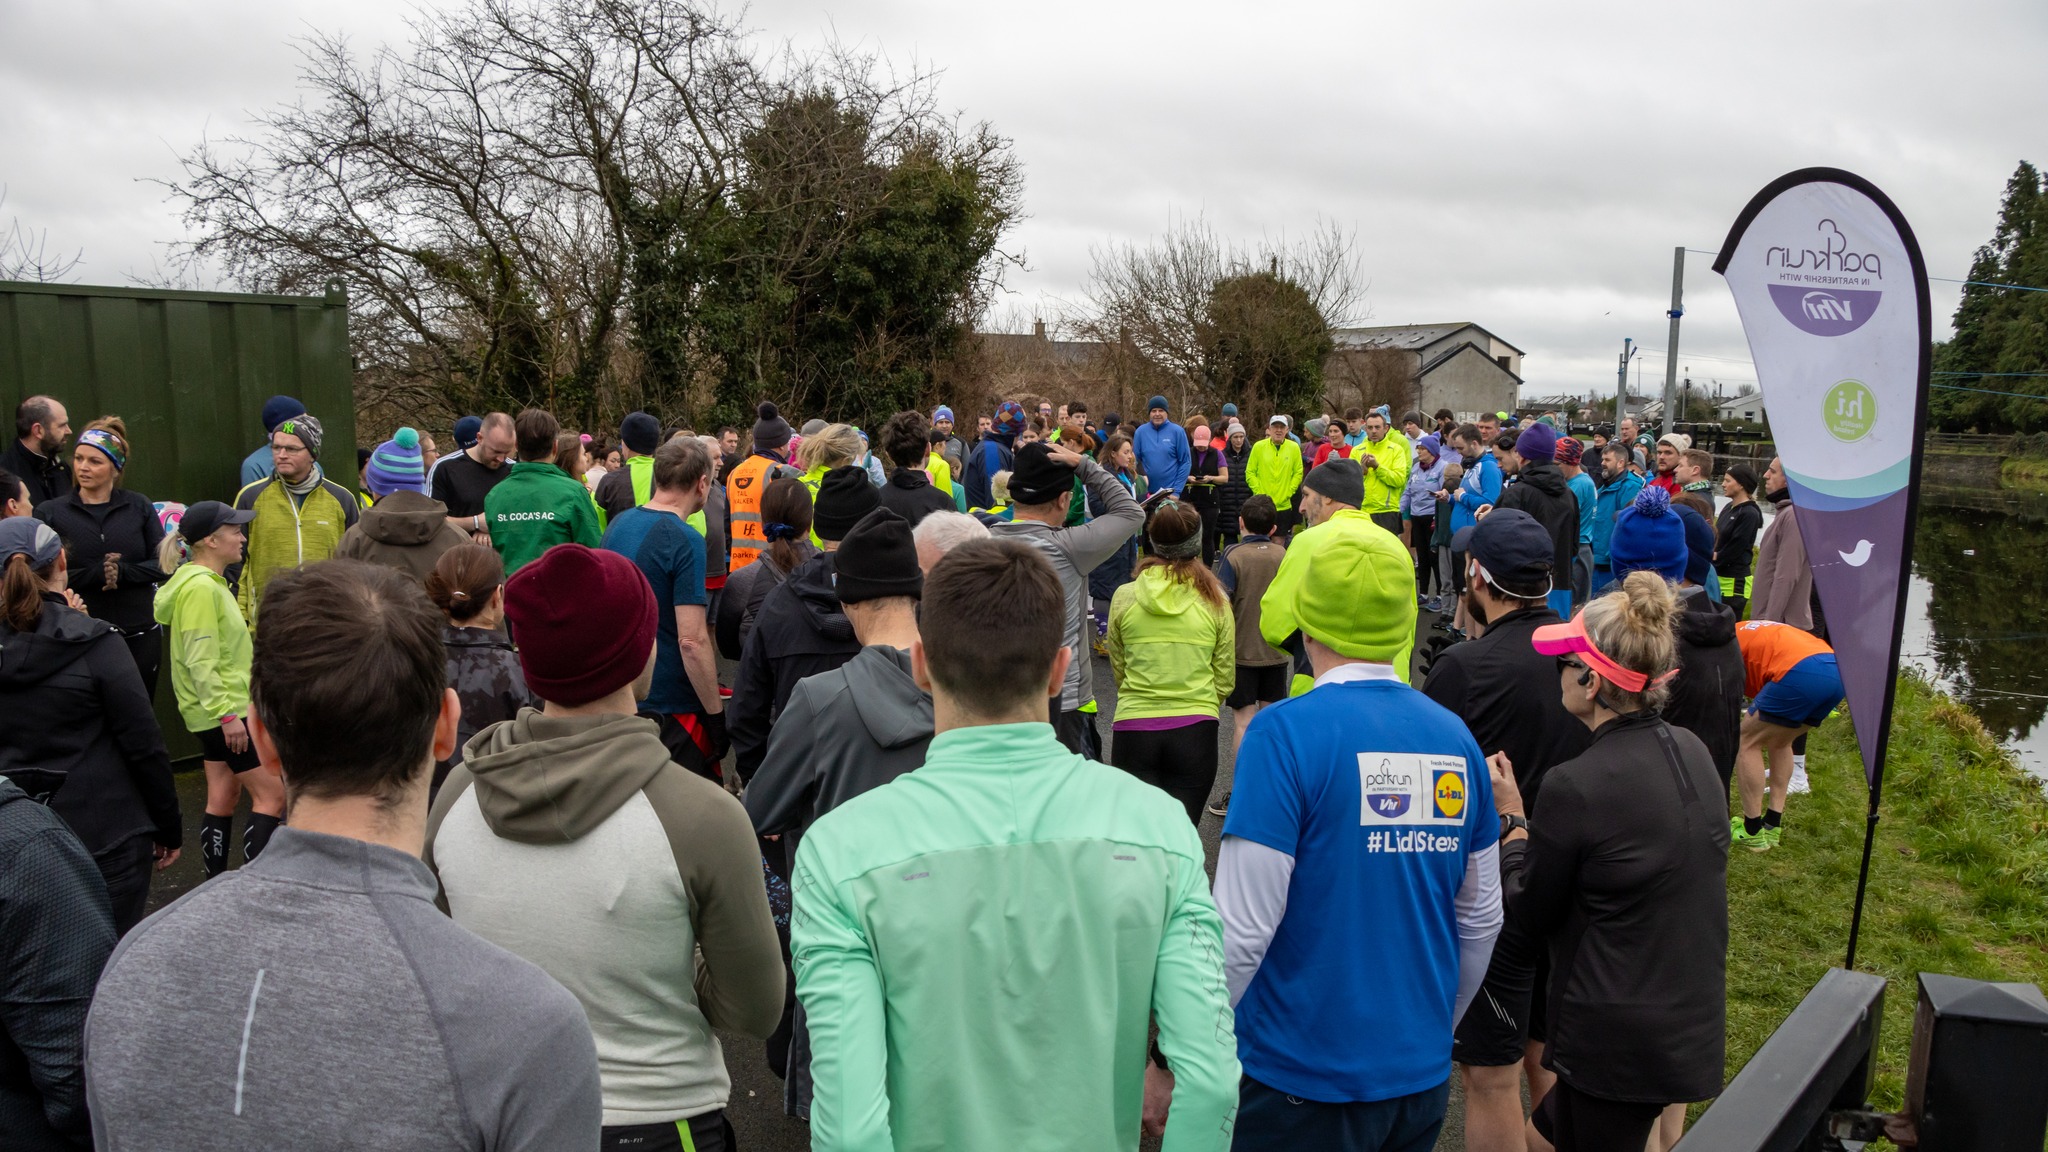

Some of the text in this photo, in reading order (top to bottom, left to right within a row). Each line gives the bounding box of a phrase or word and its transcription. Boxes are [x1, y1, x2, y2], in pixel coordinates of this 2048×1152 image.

[509, 511, 541, 521] COCA'S
[541, 511, 555, 520] AC
[1366, 767, 1412, 789] parkrun
